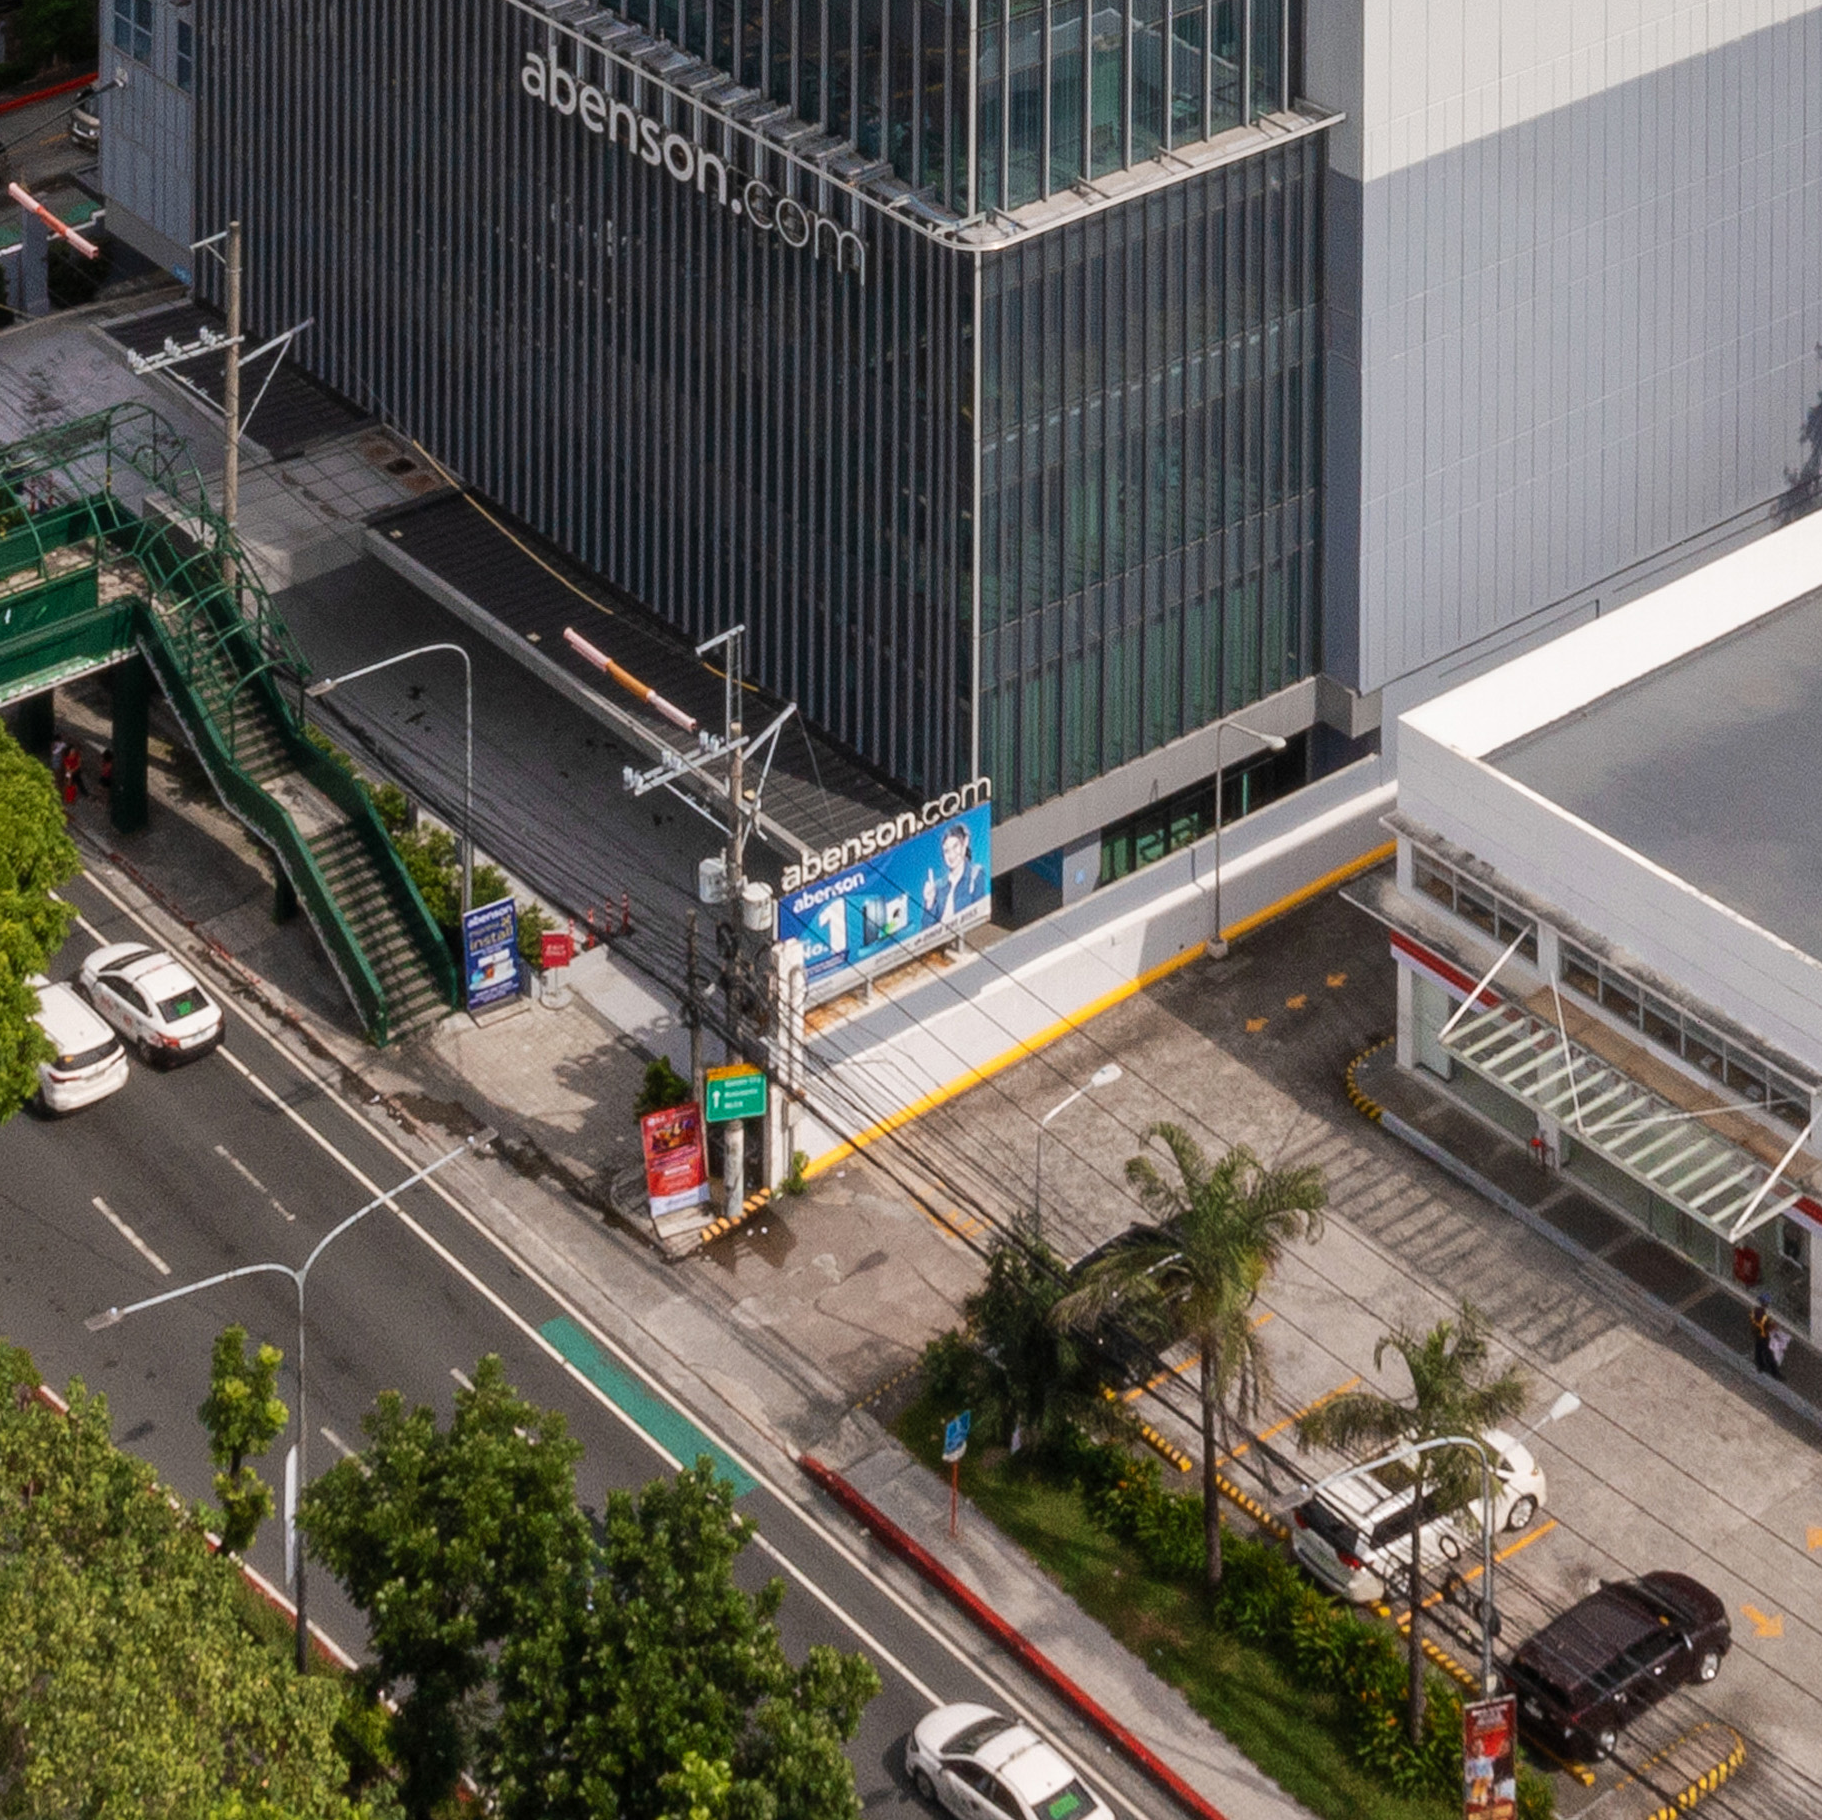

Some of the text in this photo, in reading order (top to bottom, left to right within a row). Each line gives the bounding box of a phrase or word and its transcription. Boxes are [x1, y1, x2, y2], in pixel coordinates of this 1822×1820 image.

[522, 44, 865, 286] abenson.com
[781, 776, 992, 892] abenson.com
[467, 905, 513, 928] abenson
[793, 872, 865, 914] abenson
[818, 896, 847, 954] 1
